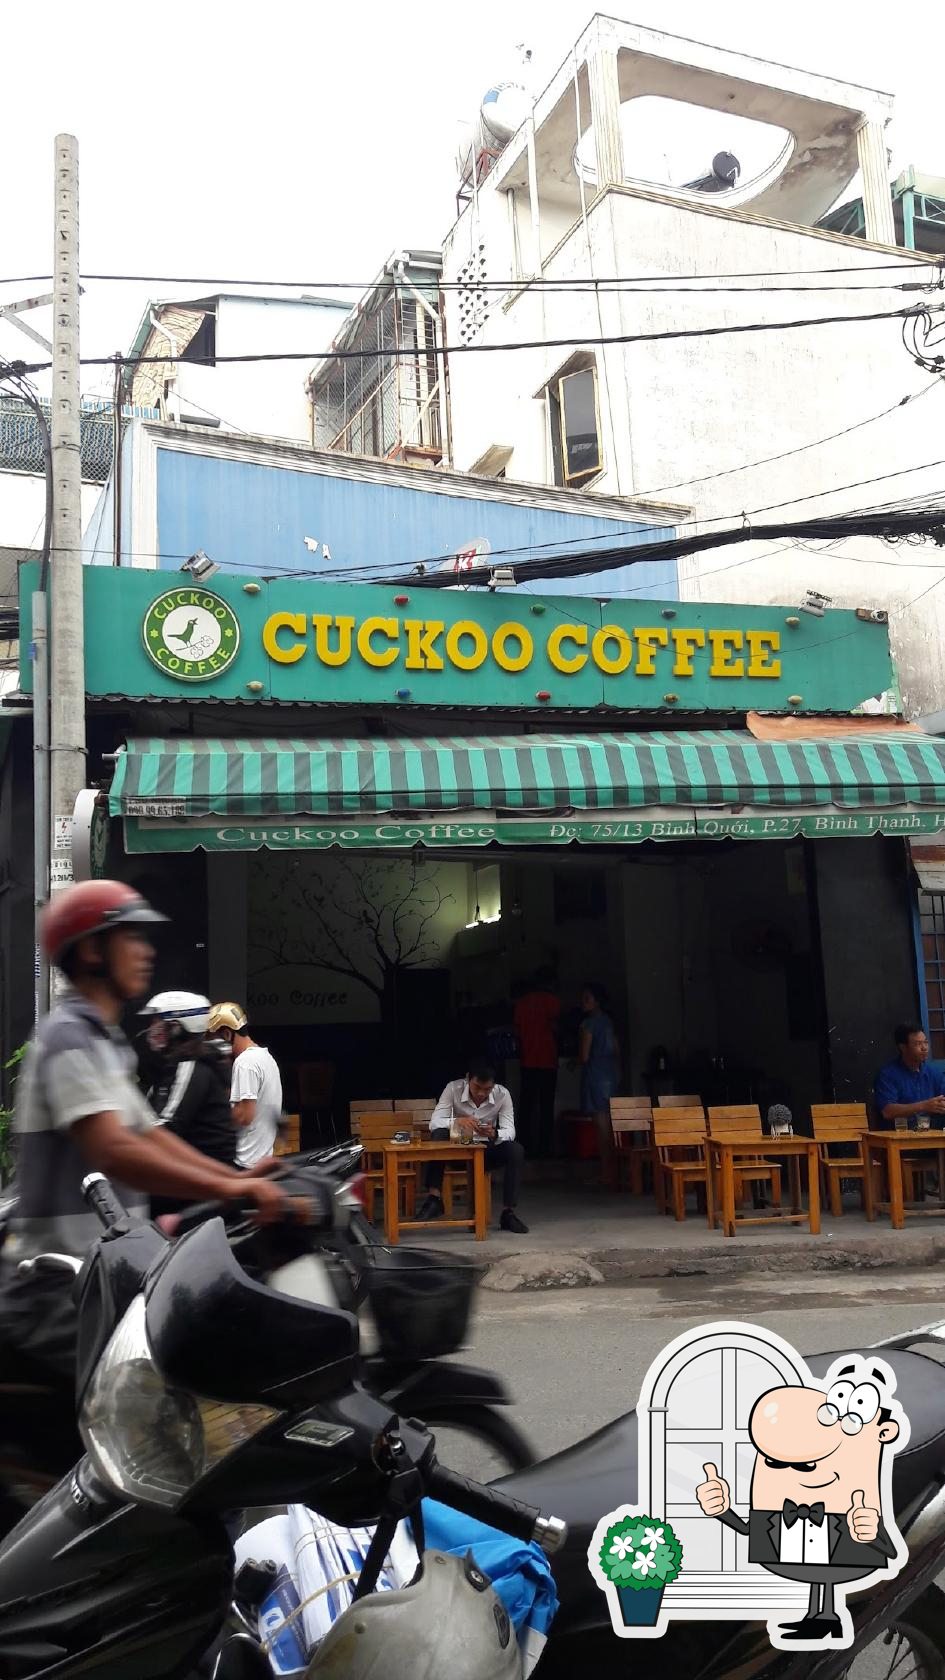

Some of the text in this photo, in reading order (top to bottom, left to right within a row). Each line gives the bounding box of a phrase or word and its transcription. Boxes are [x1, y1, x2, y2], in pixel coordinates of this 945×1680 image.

[153, 592, 227, 619] CUCKOO
[262, 611, 782, 678] CUCKOO COFFEE
[156, 647, 231, 675] COFFEE
[216, 825, 496, 842] Cuckoo Coffee
[592, 823, 643, 837] 75/13
[289, 990, 349, 1007] Coffee
